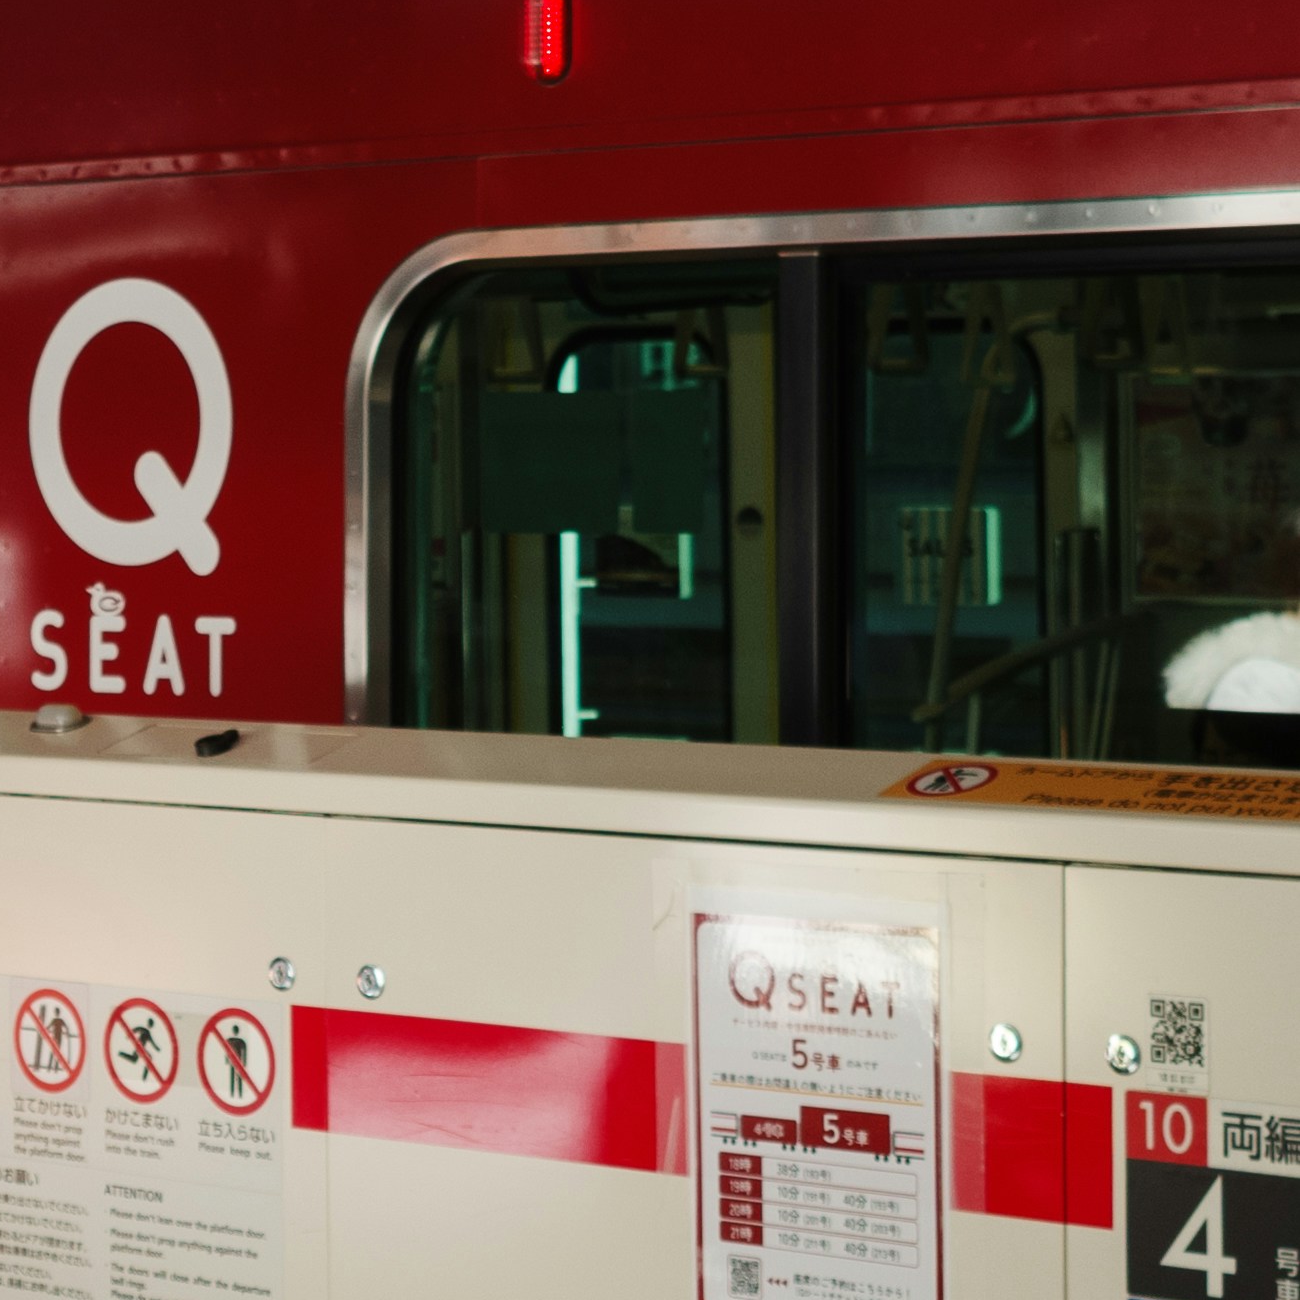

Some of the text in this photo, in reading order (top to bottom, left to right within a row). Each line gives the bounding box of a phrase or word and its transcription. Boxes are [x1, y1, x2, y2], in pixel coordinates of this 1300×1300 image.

[28, 277, 233, 576] Q
[30, 609, 237, 697] SEAT
[1023, 793, 1288, 819] Please do not put your
[728, 950, 901, 1019] Q SEAT
[792, 1038, 841, 1071] 5号車
[13, 1096, 88, 1119] 立てかけない
[105, 1108, 179, 1131] かけこまない
[198, 1120, 275, 1144] 立ち入らない
[823, 1113, 869, 1146] 5号車
[1139, 1099, 1300, 1166] 10 両編
[104, 1183, 163, 1203] ATTENTION
[1160, 1174, 1237, 1299] 4
